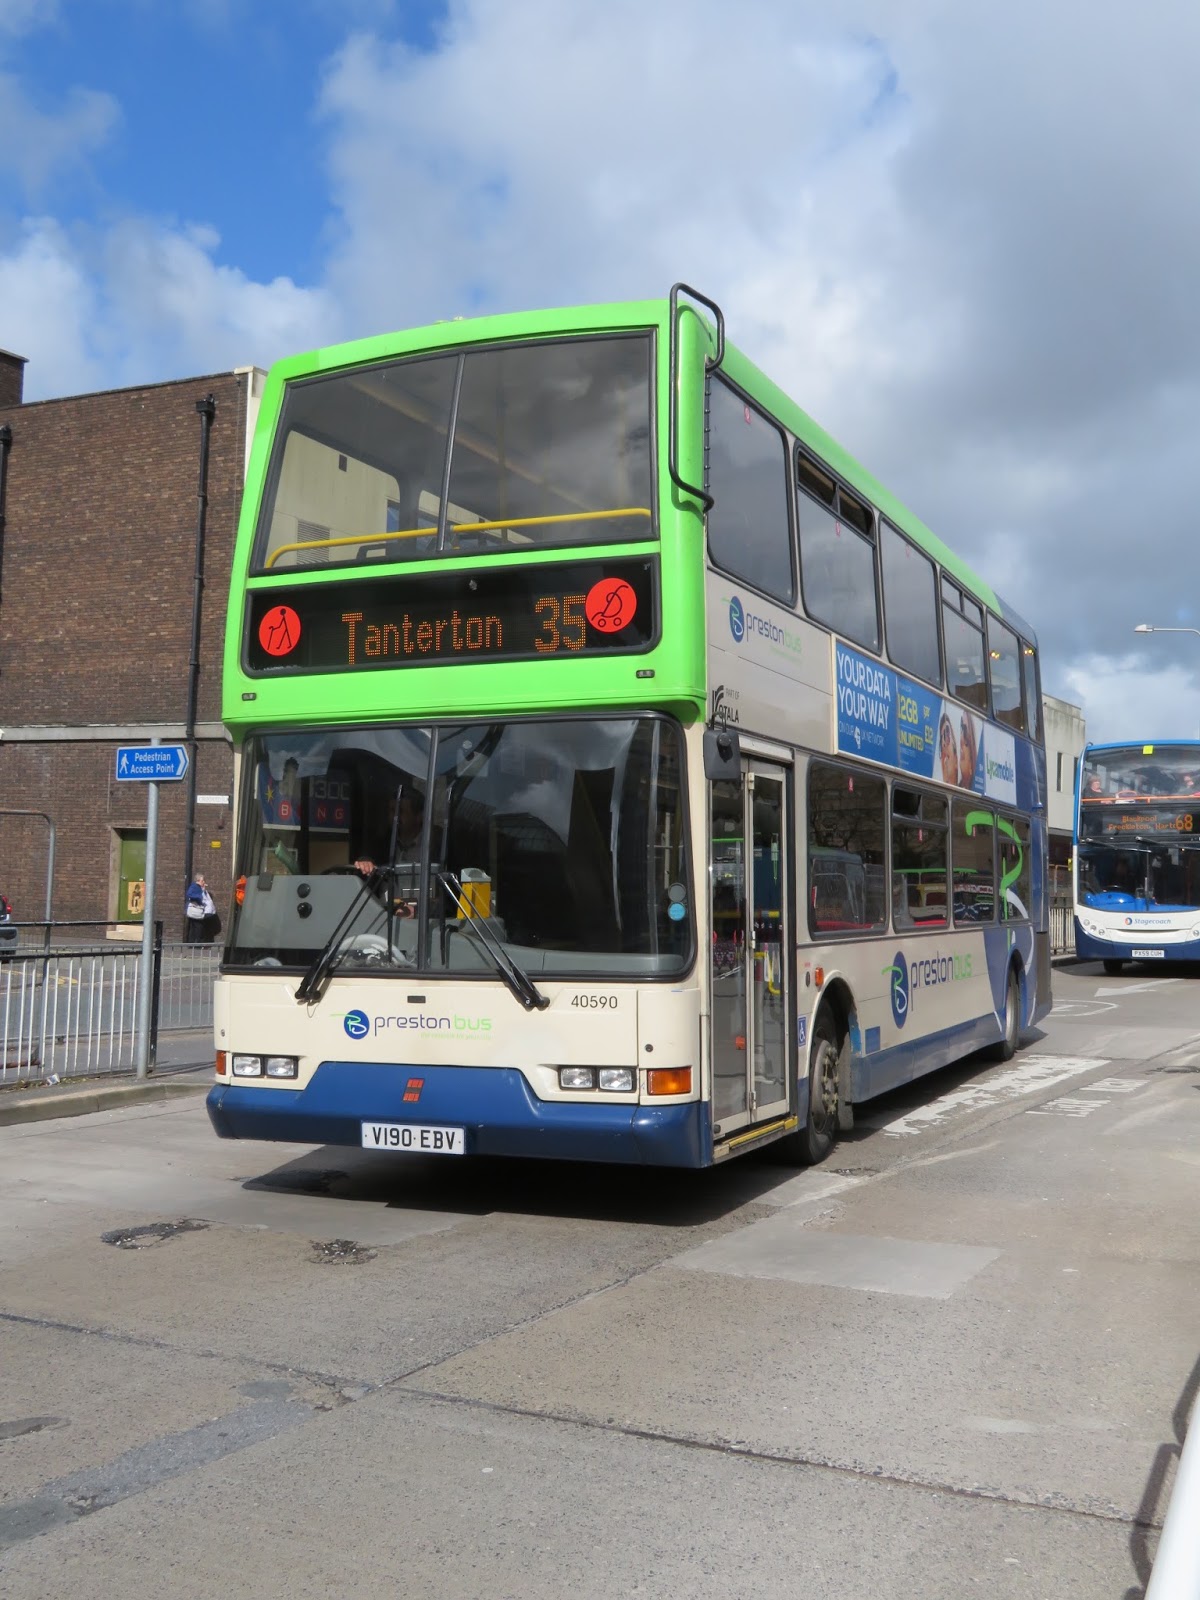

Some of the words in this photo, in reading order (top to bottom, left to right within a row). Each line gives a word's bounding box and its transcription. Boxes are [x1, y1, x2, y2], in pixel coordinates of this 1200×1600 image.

[341, 610, 503, 665] Tanterton
[535, 595, 587, 653] 35
[837, 650, 866, 690] YOUR
[866, 665, 891, 702] DATA
[838, 683, 867, 722] YOUR
[867, 697, 890, 730] WAY
[134, 752, 171, 762] Pedestrian
[130, 764, 154, 774] Access
[155, 763, 175, 773] Point
[1176, 813, 1193, 831] 68
[1134, 918, 1171, 926] Stagecoach
[571, 995, 618, 1009] 40590
[372, 1126, 412, 1147] V190
[420, 1129, 455, 1150] EBV
